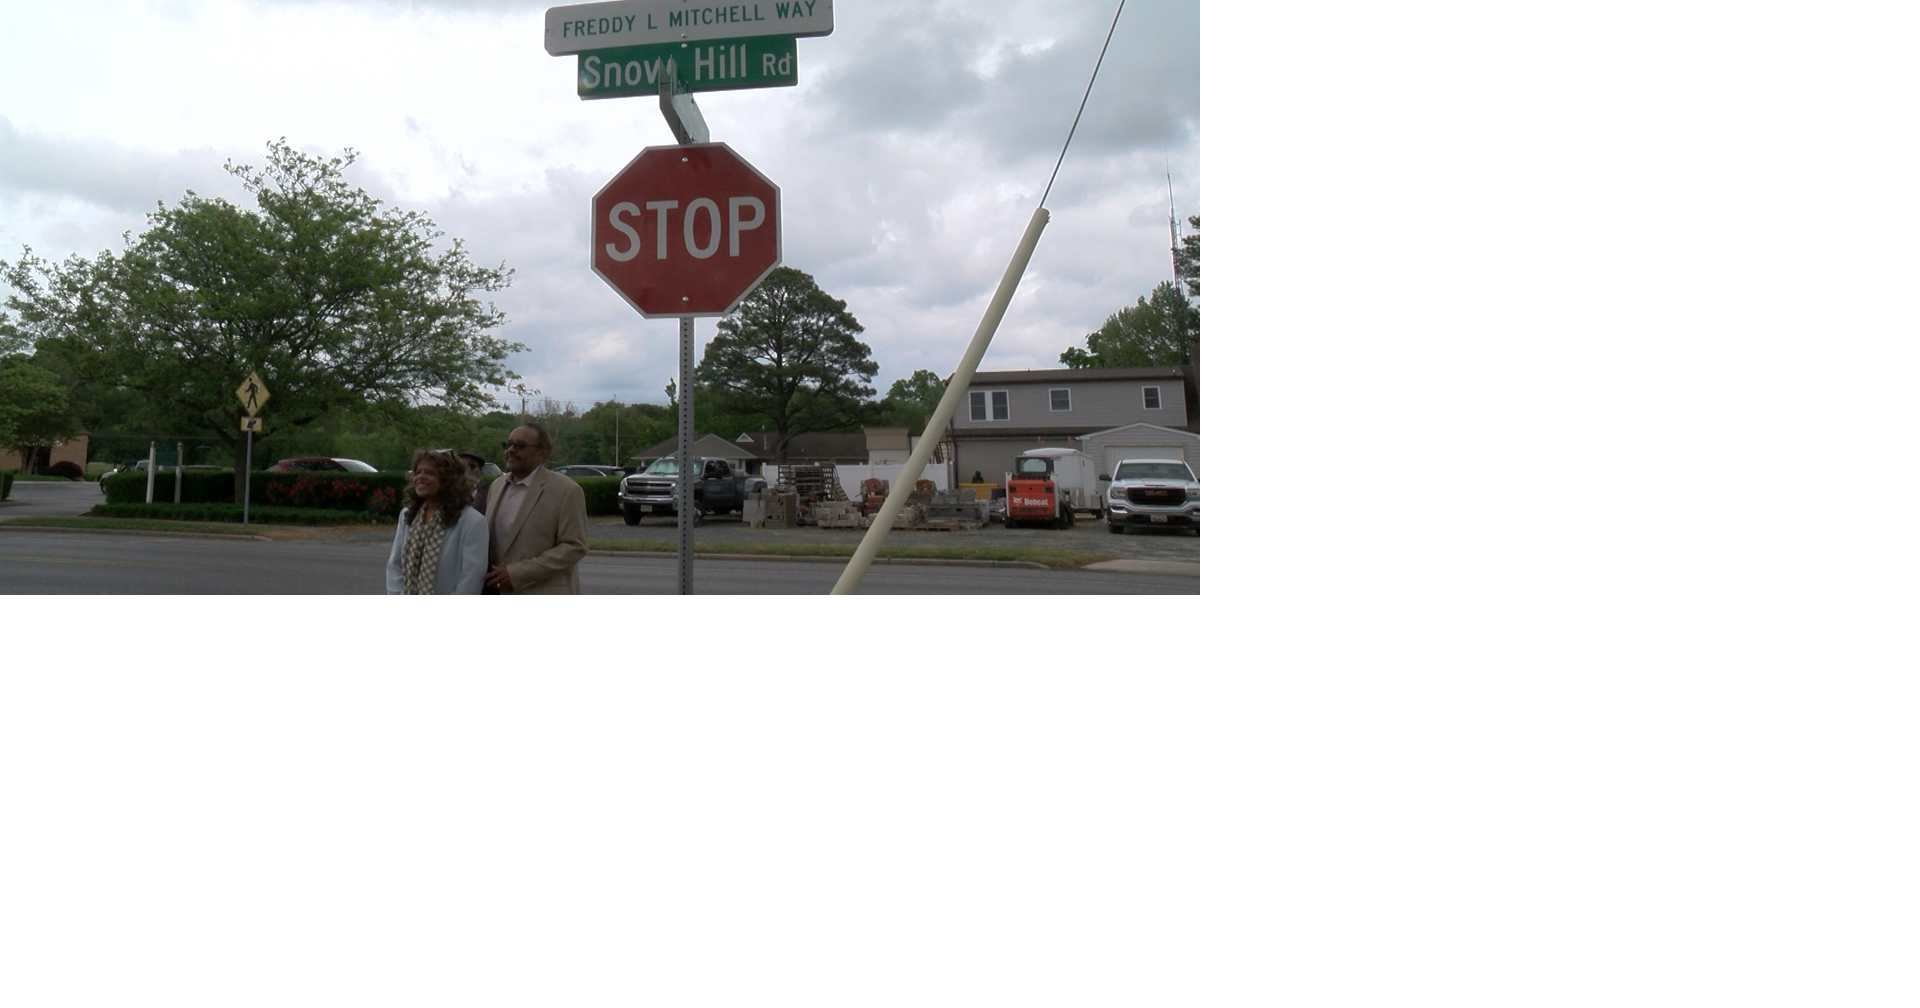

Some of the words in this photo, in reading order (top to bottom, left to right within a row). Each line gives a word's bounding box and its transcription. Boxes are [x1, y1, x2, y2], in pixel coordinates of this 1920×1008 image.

[563, 15, 636, 38] FREDDY
[647, 13, 657, 30] L
[669, 4, 765, 28] MITCHELL
[776, 0, 816, 19] WAY
[695, 44, 747, 81] Hill
[762, 52, 791, 76] Rd
[605, 197, 766, 262] STOP
[1024, 498, 1048, 506] Bobcat
